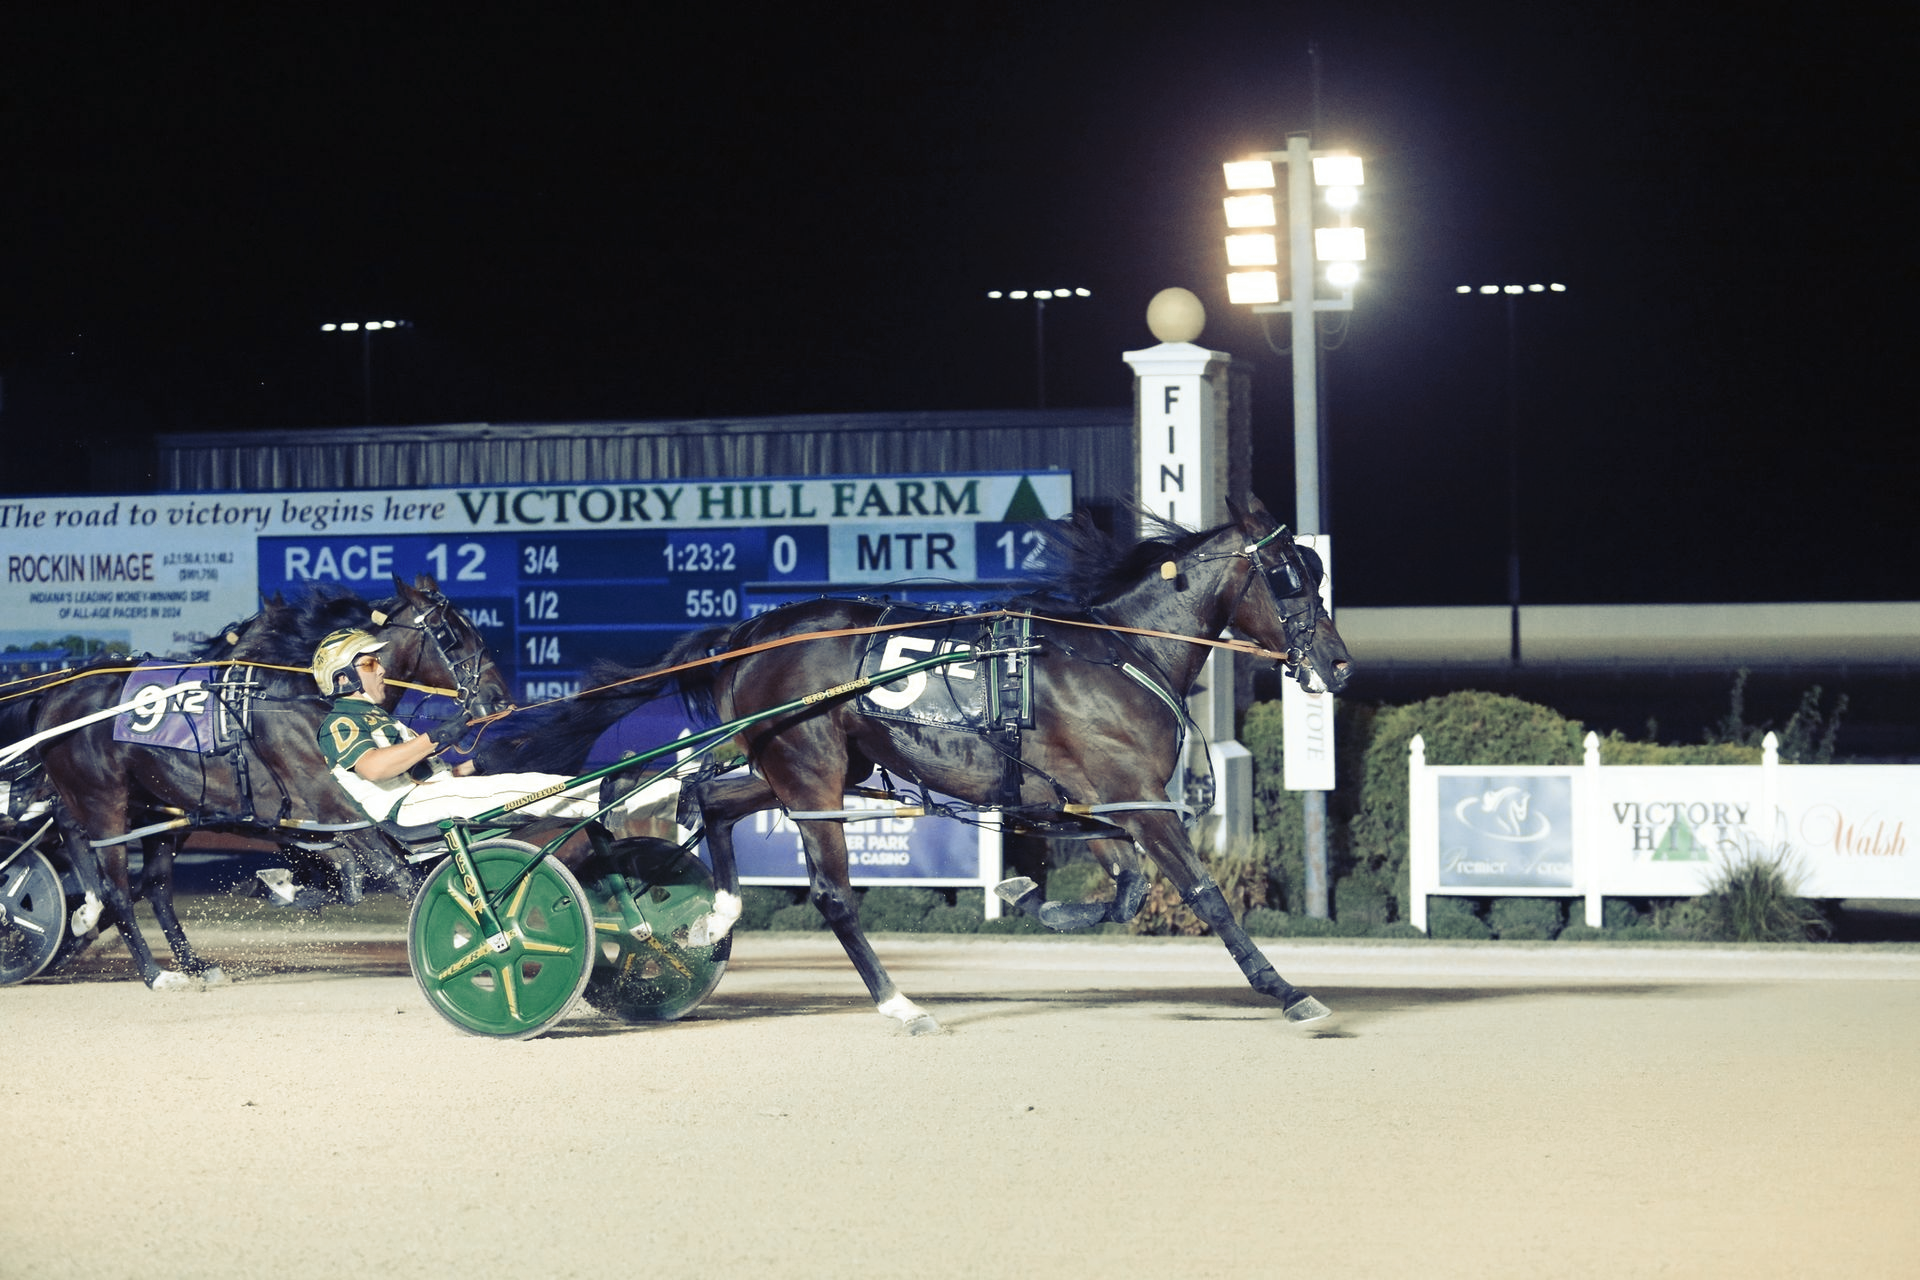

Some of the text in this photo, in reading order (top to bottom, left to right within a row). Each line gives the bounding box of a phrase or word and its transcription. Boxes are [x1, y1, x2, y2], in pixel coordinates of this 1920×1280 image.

[1160, 385, 1184, 522] FINI
[0, 496, 445, 531] The road to victory begins here
[457, 479, 980, 525] VICTORY HILL FARM
[285, 543, 487, 581] RACE 12
[524, 543, 736, 574] 3/4 1:23:2
[772, 534, 797, 574] 0
[857, 532, 958, 571] MTR
[996, 530, 1047, 570] 12
[8, 553, 154, 583] ROCKIN IMAGE
[29, 590, 211, 604] INDIANA'S LEADING MONEY-WINNING SIRE
[59, 608, 71, 619] OF
[73, 607, 111, 619] ALL-AGE
[113, 607, 148, 618] PACERS
[150, 607, 159, 618] IN
[525, 591, 559, 620] 1/2
[686, 589, 738, 618] 55:0
[526, 636, 560, 665] 1/4
[866, 635, 936, 710] 5
[131, 685, 167, 732] 9
[504, 796, 529, 811] JOHN
[1612, 802, 1749, 825] VICTORY
[866, 835, 910, 850] PARK
[1800, 803, 1906, 857] Walsh
[860, 852, 910, 865] CASINO
